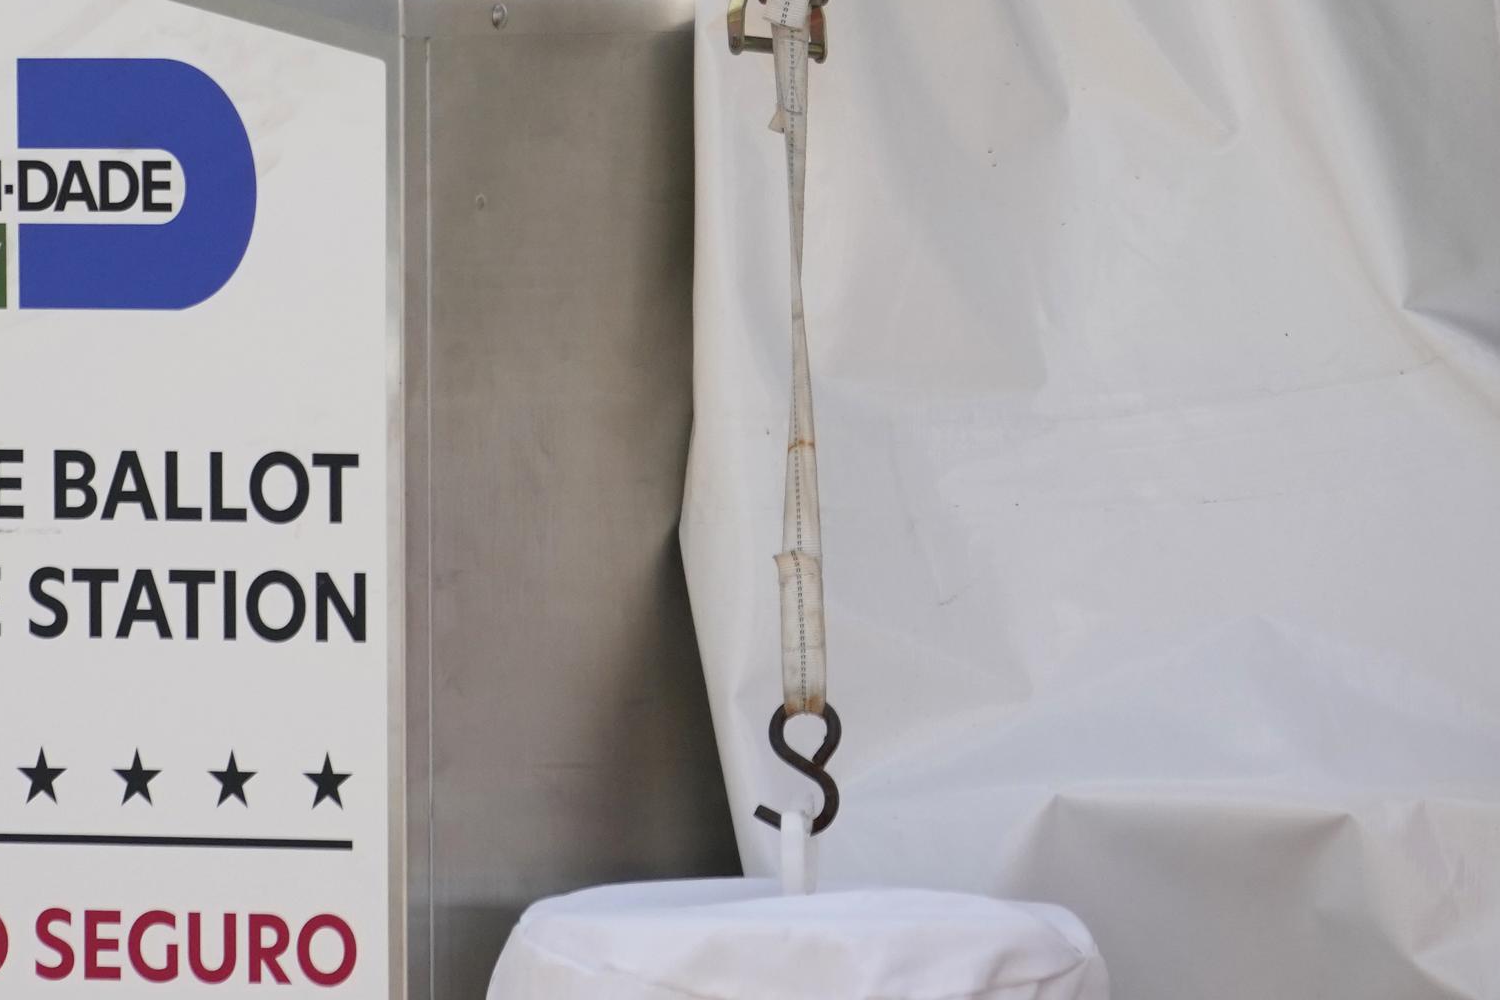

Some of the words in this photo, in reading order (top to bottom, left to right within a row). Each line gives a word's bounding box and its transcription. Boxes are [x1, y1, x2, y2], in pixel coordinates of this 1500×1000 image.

[54, 450, 359, 523] BALLOT
[30, 567, 366, 642] STATION
[36, 908, 356, 986] SEGURO
